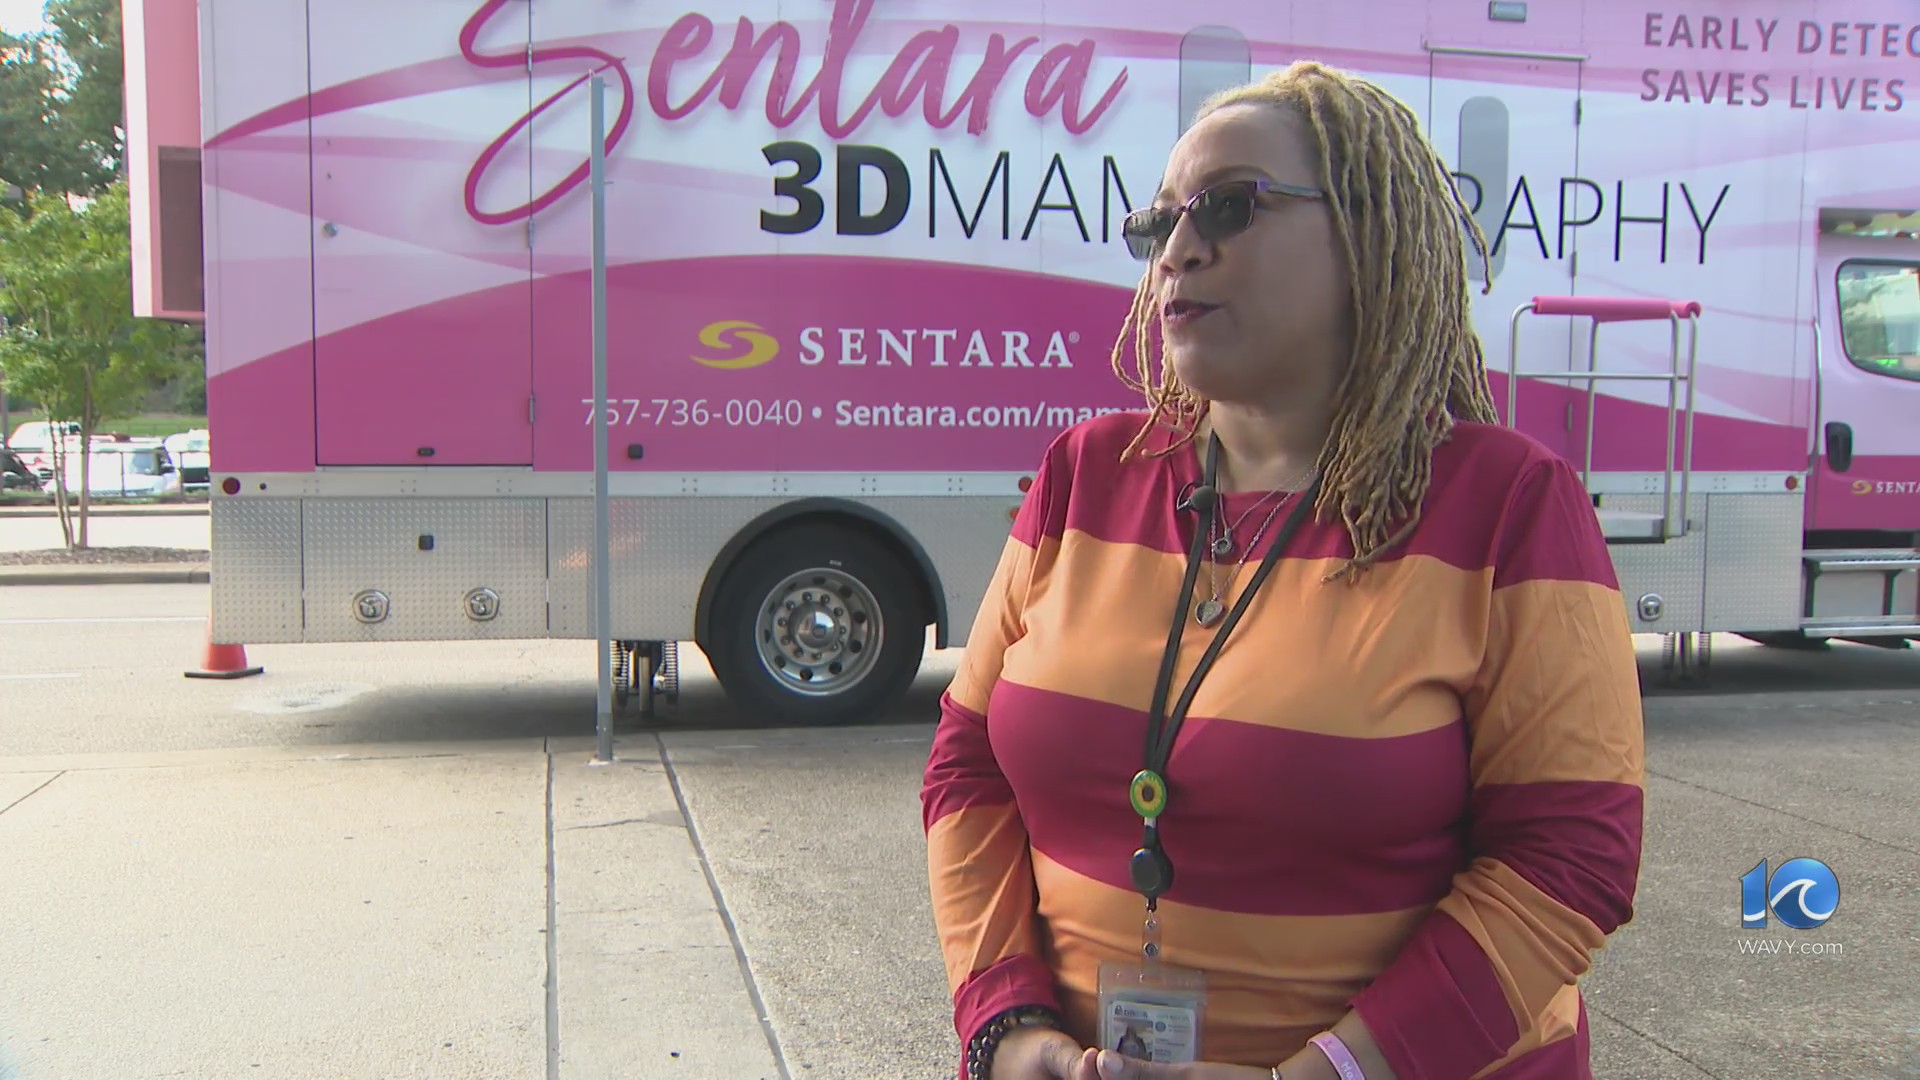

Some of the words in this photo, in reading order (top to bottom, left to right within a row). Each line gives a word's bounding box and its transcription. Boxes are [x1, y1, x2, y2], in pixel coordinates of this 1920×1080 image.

[1644, 12, 1778, 52] EARLY
[1640, 68, 1770, 107] SAVES
[1790, 76, 1905, 112] LIVES
[460, 0, 1128, 225] Sentara
[582, 398, 802, 426] 757-736-0040
